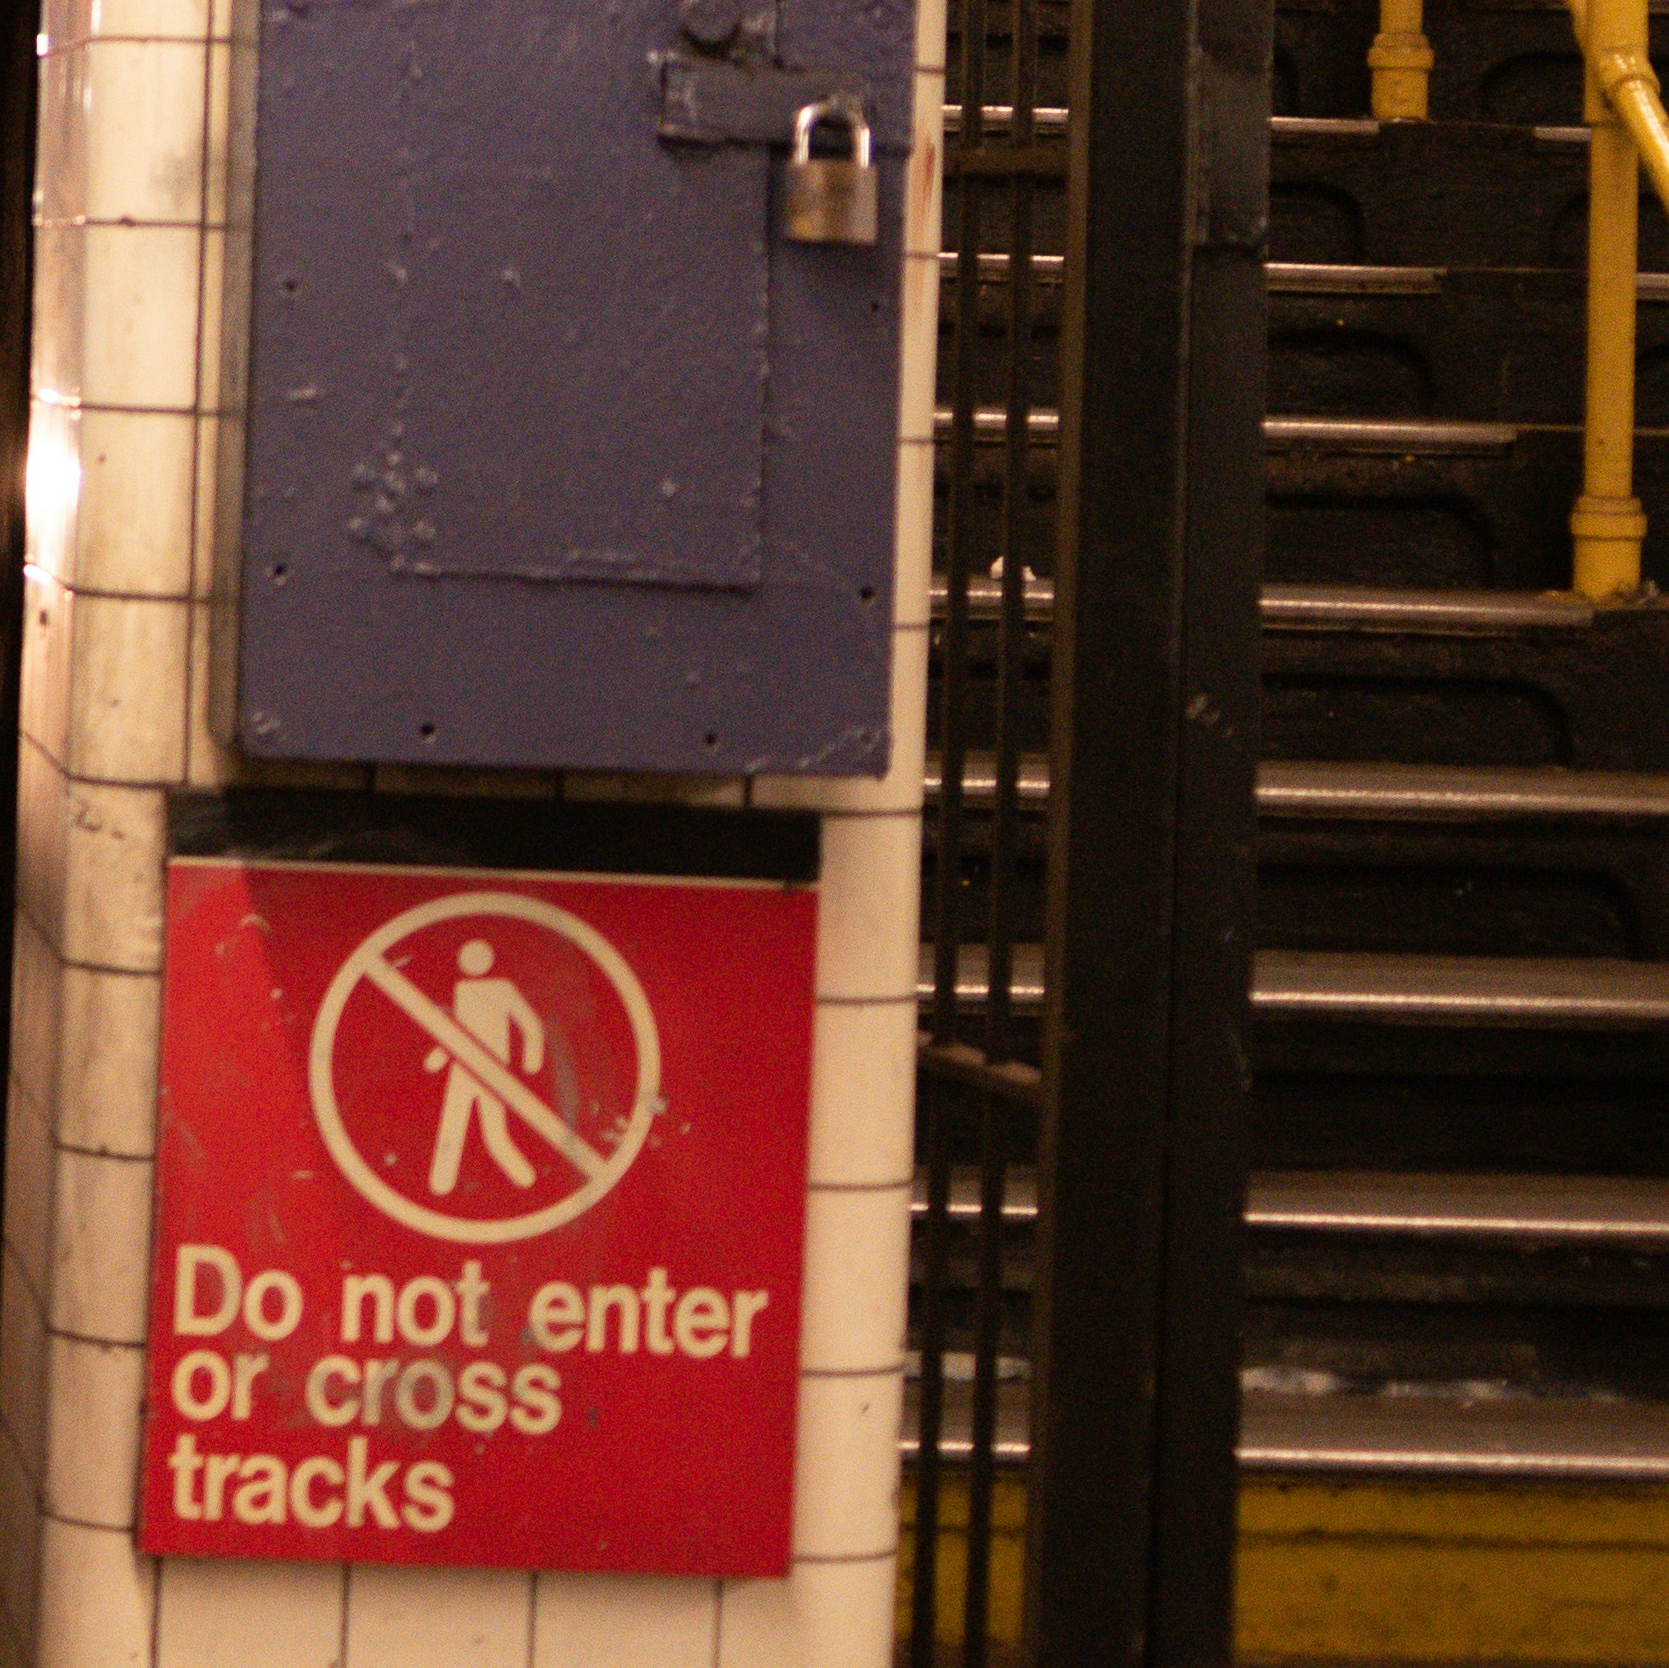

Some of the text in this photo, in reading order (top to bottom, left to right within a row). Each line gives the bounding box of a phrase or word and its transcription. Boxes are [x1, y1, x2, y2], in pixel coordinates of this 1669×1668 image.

[172, 1244, 769, 1359] Do not enter
[171, 1348, 562, 1435] or cross
[169, 1434, 455, 1533] tracks
